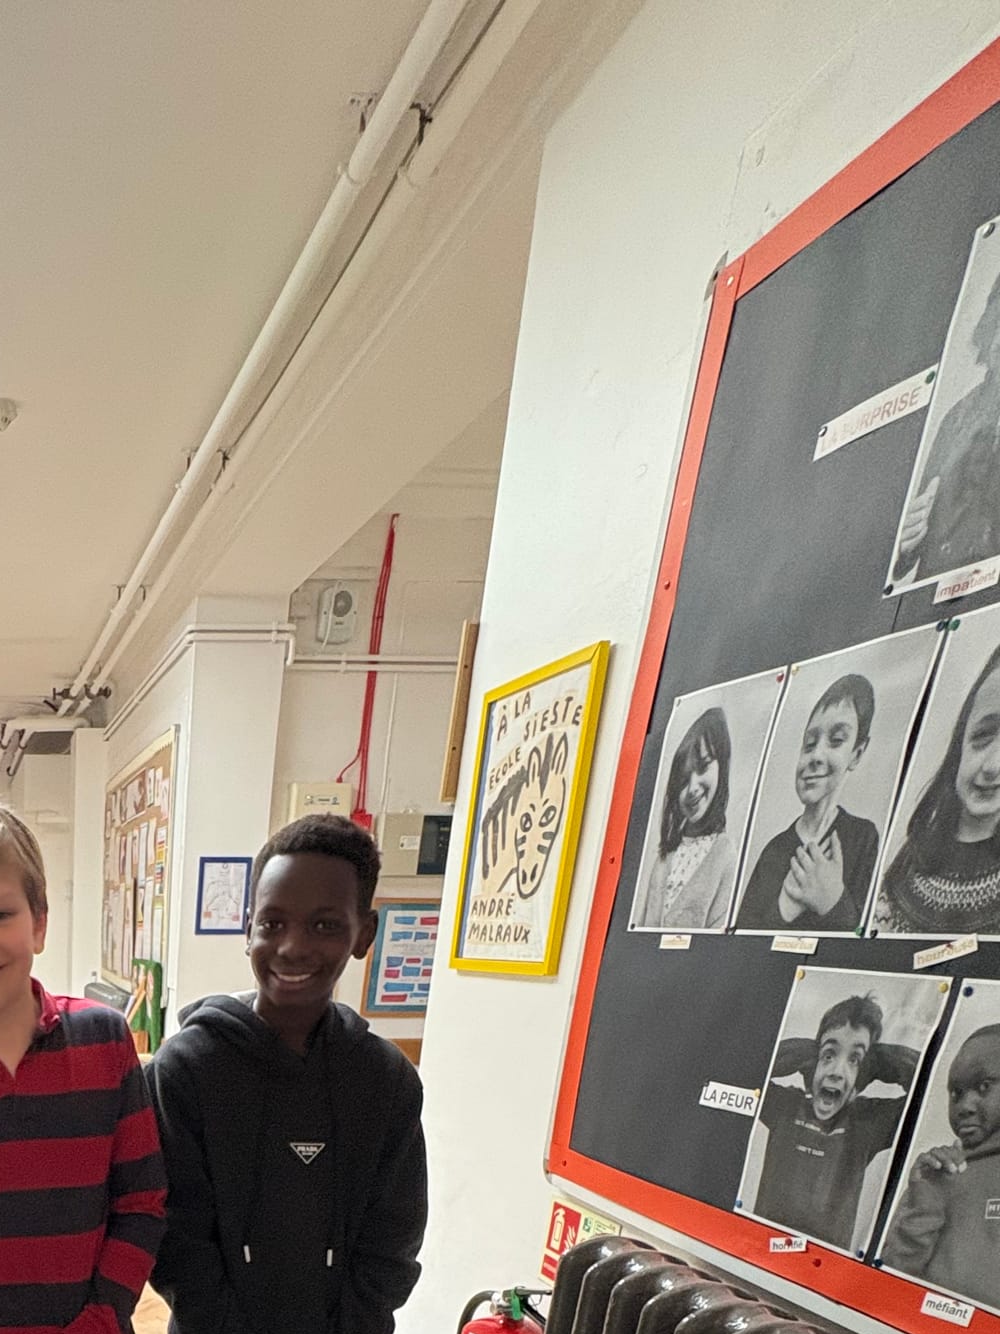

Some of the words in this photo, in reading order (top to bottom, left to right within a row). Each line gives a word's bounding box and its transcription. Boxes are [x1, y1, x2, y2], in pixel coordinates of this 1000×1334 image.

[514, 690, 531, 719] LA
[489, 746, 521, 790] ÉCOLE
[468, 922, 530, 944] MALRAUX
[703, 1087, 718, 1103] LA
[719, 1091, 755, 1111] PEUR
[925, 1299, 969, 1319] méfiant
